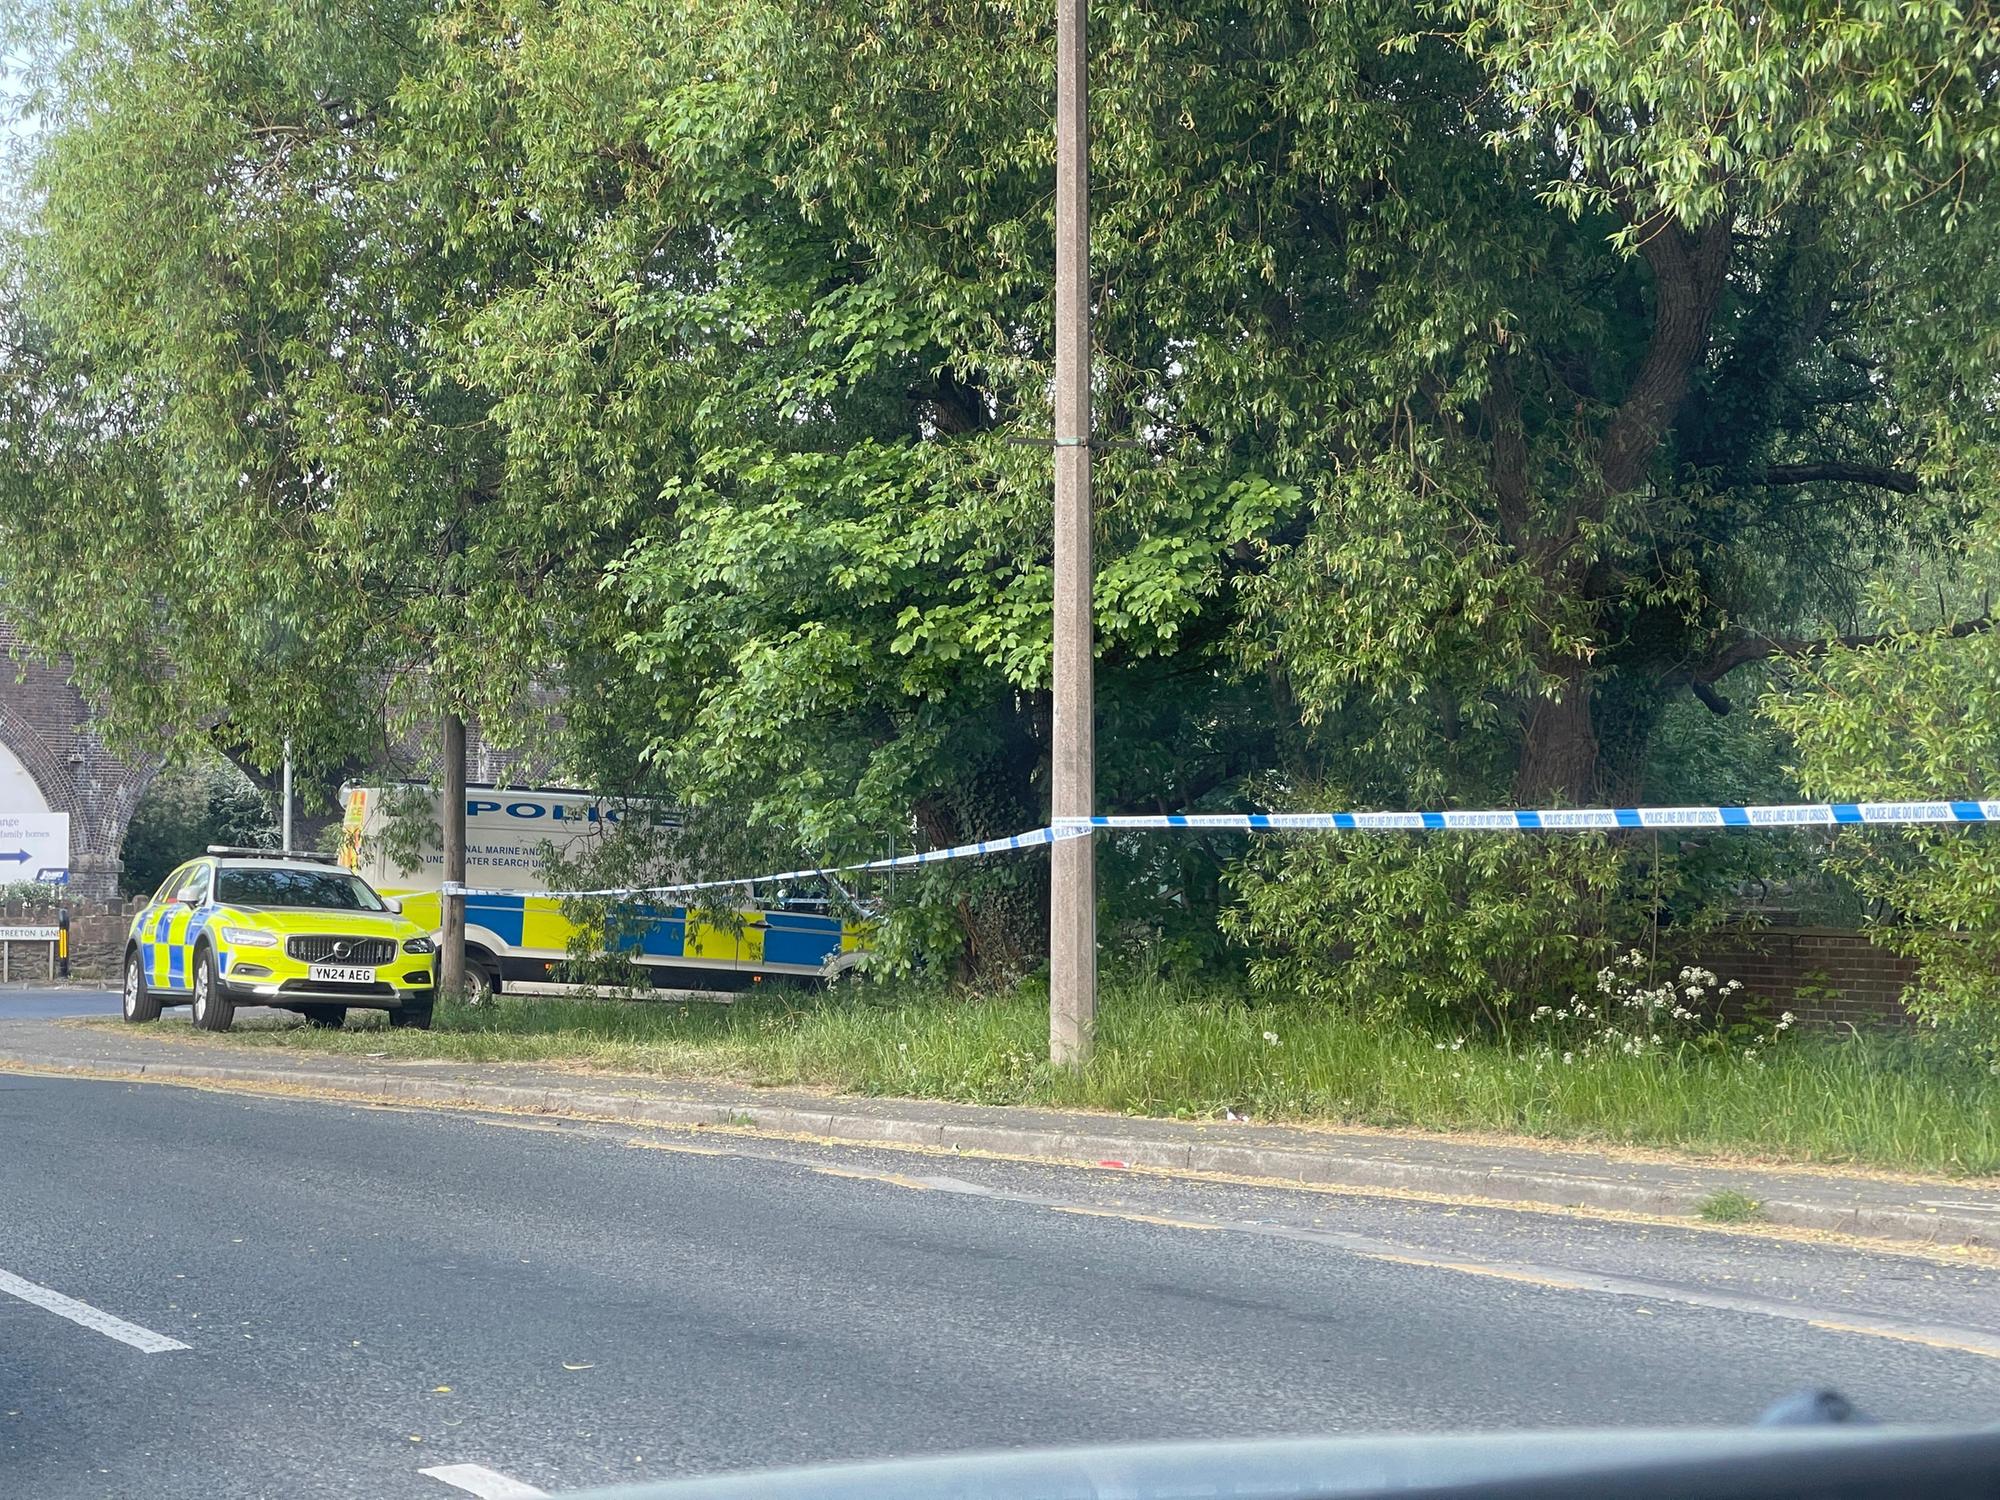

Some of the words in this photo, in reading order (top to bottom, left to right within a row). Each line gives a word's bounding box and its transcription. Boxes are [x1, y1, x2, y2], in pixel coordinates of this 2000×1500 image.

[1544, 814, 1562, 825] POLICE
[1562, 814, 1574, 825] LINE
[1574, 814, 1583, 825] DO
[1584, 813, 1594, 824] NOT
[1595, 813, 1613, 824] CROSS
[1645, 812, 1663, 824] POLICE
[1663, 812, 1676, 824] LINE
[1676, 812, 1685, 824] DO
[1685, 811, 1697, 823] NOT
[1698, 811, 1717, 823] CROSS
[1752, 811, 1772, 823] POLICE
[1773, 811, 1786, 823] LINE
[1786, 810, 1795, 822] DO
[1796, 809, 1808, 821] NOT
[1809, 809, 1829, 821] CROSS
[1866, 807, 1887, 820] POLICE
[1888, 807, 1901, 820] LINE
[1902, 807, 1911, 820] DO
[1912, 806, 1925, 819] NOT
[1926, 806, 1948, 819] CROSS
[1449, 815, 1465, 826] POLICE
[1465, 815, 1477, 826] LINE
[1477, 815, 1485, 826] DO
[1485, 815, 1495, 826] NOT
[1496, 815, 1513, 826] CROSS
[485, 846, 521, 856] MARINE
[522, 847, 543, 856] AND
[491, 859, 529, 868] SEARCH
[0, 929, 36, 938] TREETON
[316, 968, 345, 980] YN24
[348, 969, 370, 981] AEG
